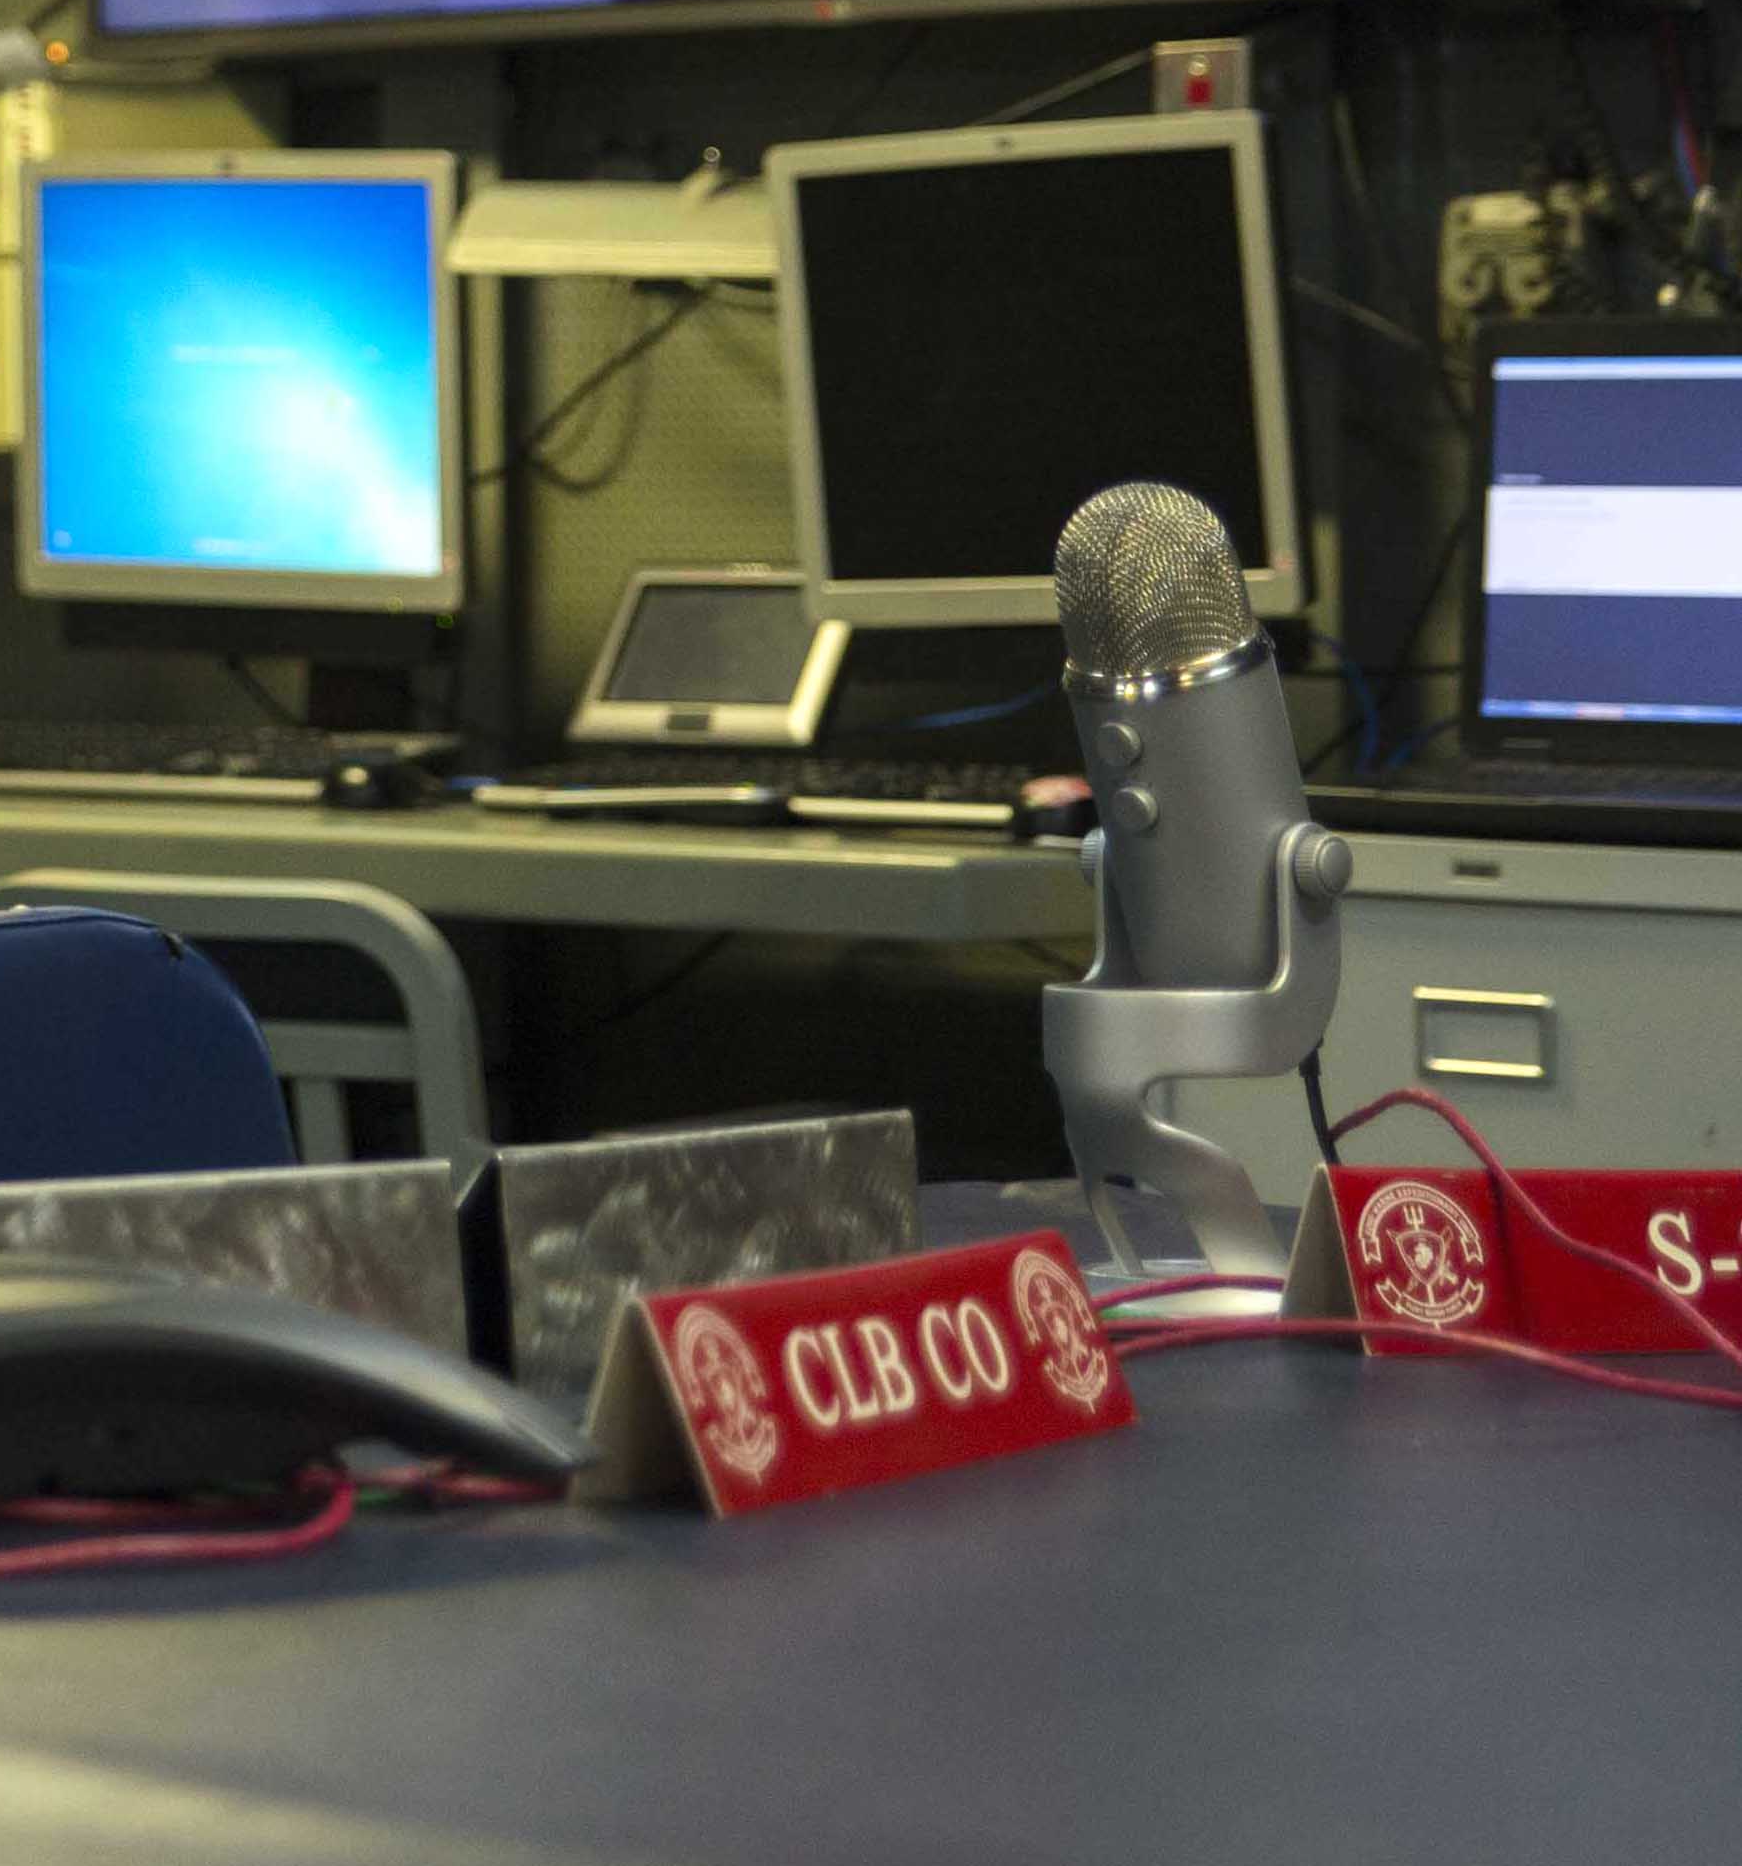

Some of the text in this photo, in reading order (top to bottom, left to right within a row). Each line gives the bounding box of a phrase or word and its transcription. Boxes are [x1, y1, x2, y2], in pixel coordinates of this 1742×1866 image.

[1648, 1211, 1742, 1295] S-
[786, 1299, 1009, 1428] CLB CO
